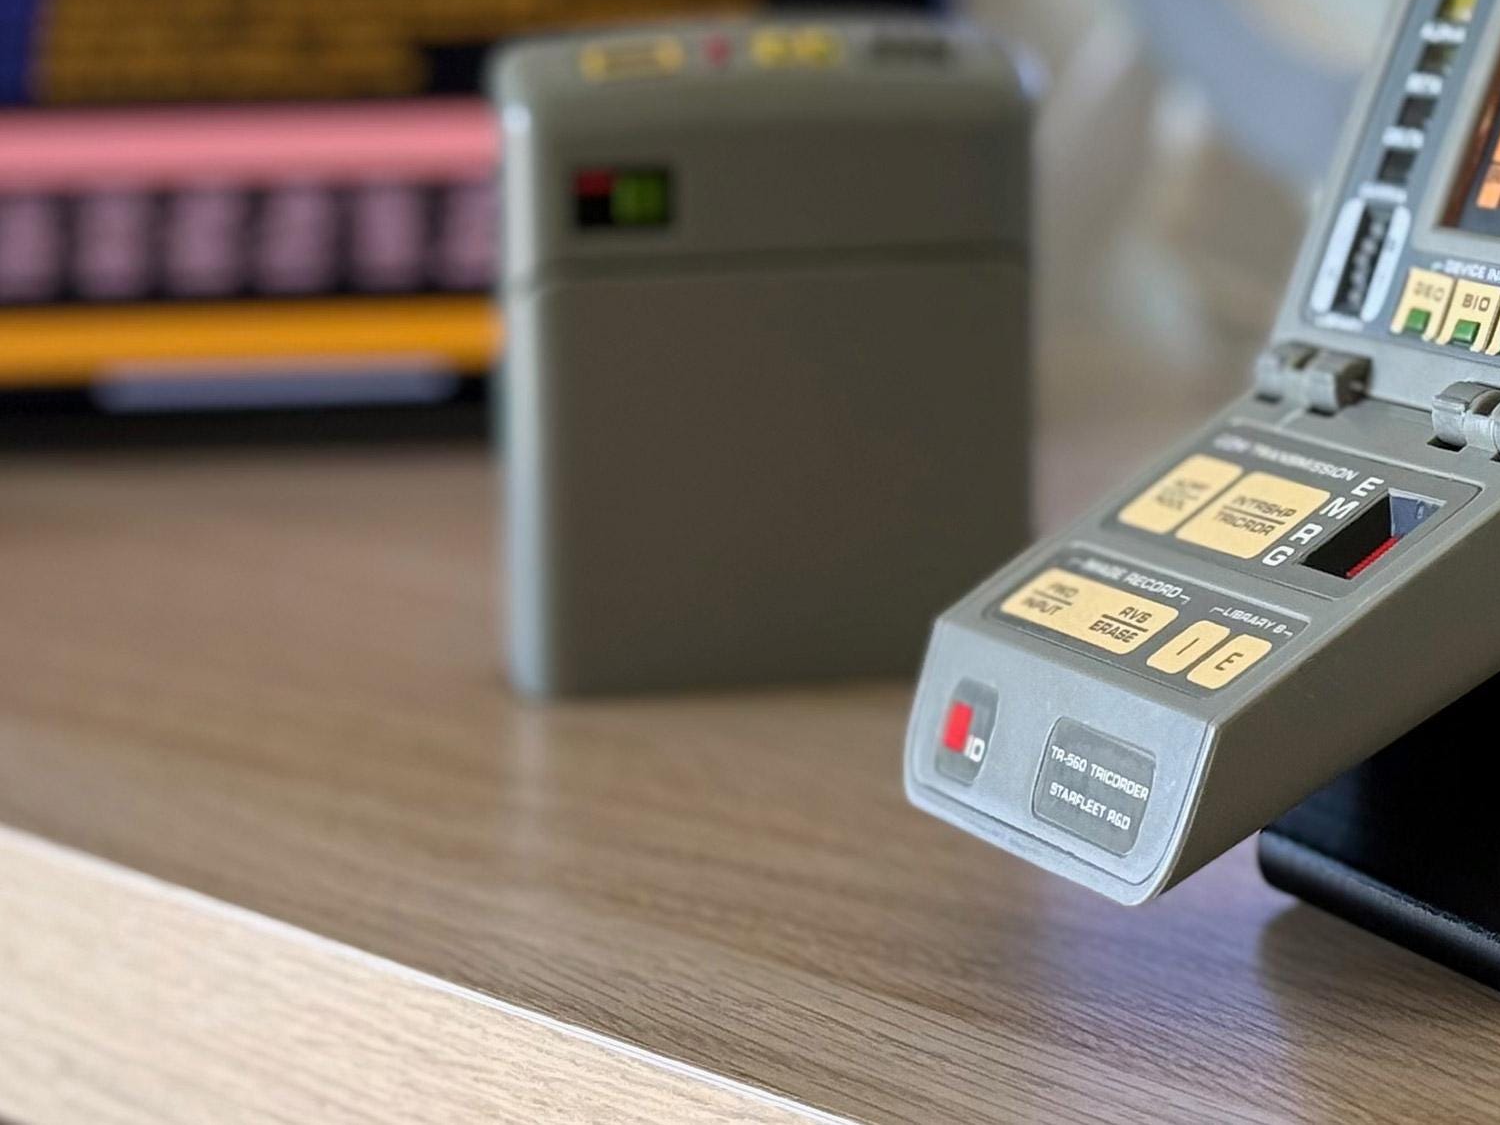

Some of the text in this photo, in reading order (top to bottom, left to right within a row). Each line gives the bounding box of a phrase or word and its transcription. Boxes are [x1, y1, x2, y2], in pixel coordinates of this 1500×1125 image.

[1462, 293, 1491, 312] BIO
[1123, 572, 1184, 598] RECORD
[1223, 607, 1277, 631] LIBRARY
[1088, 620, 1143, 644] ERASE
[1214, 652, 1244, 672] E
[963, 734, 986, 762] ID
[1050, 745, 1150, 801] TR-560 TRICORDER
[1049, 782, 1106, 818] STARFLEET
